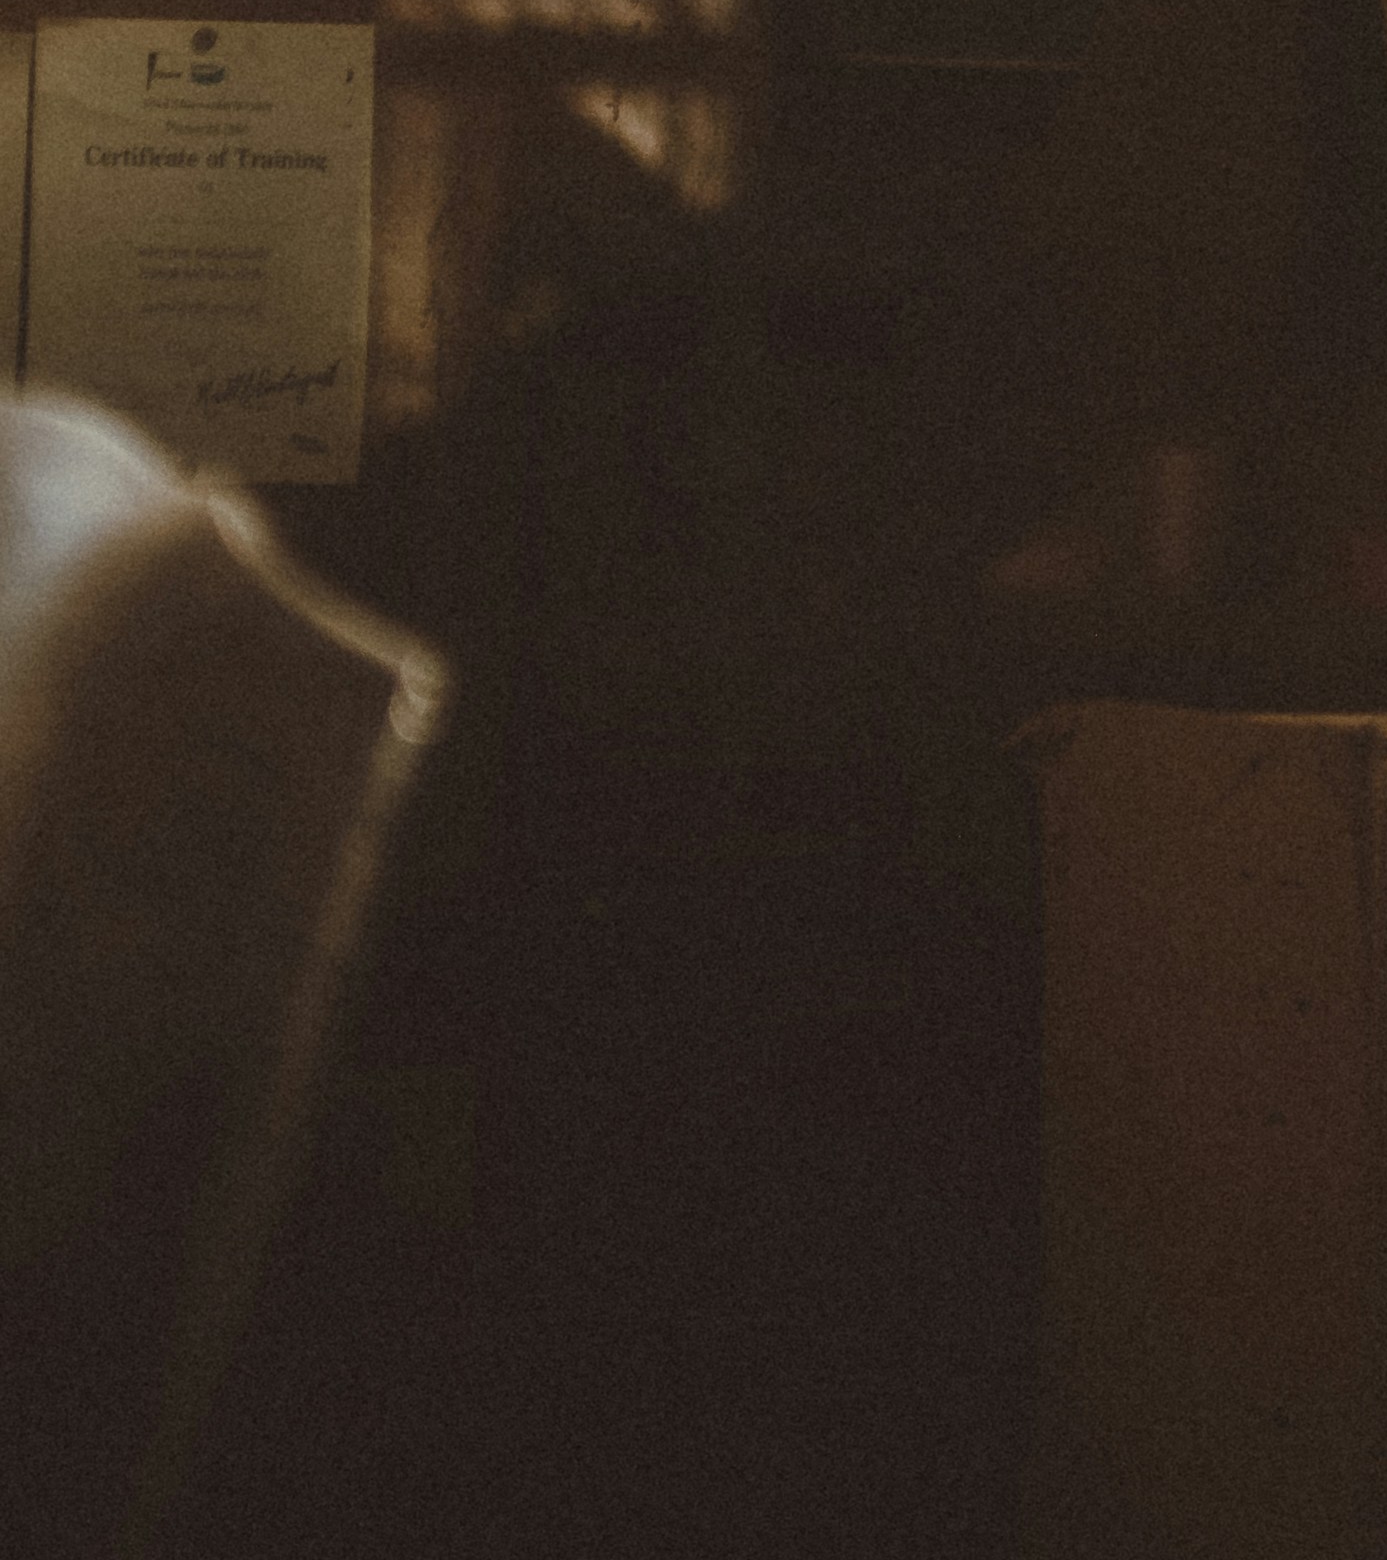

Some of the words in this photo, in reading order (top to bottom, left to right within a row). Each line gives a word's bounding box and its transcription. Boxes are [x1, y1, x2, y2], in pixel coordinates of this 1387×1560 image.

[84, 145, 199, 168] Certificate
[206, 144, 228, 168] of
[235, 147, 327, 172] Training
